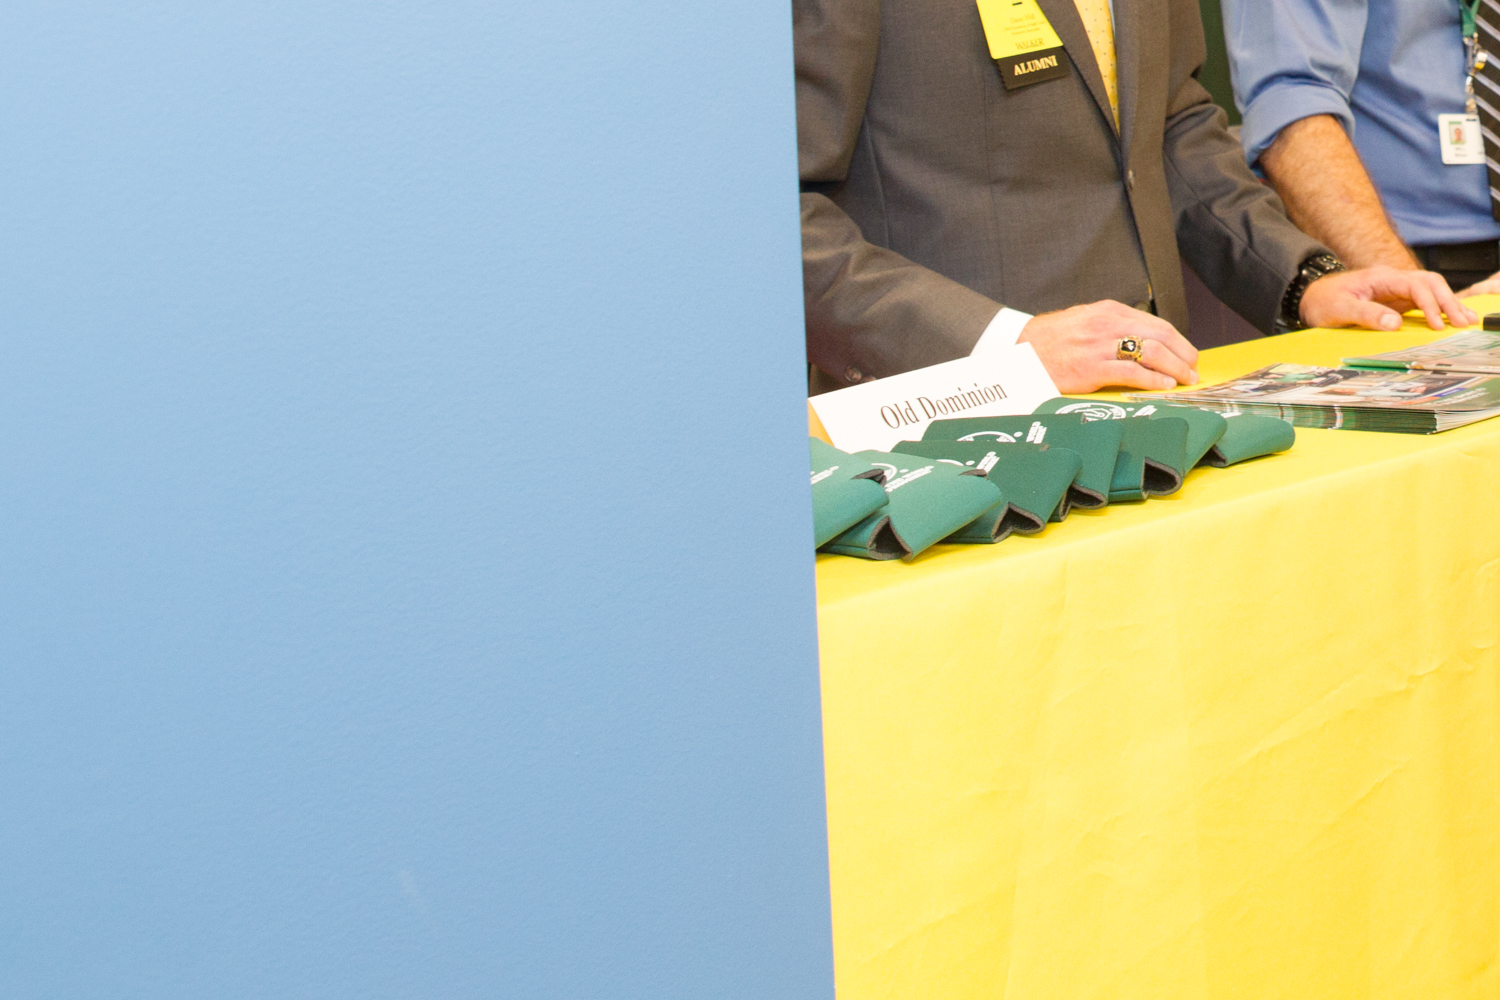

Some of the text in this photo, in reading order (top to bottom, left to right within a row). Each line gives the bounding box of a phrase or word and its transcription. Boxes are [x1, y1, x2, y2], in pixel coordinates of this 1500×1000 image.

[1015, 38, 1044, 50] WALKER
[1014, 55, 1058, 75] ALUMNI
[880, 382, 1008, 430] Old Dominion
